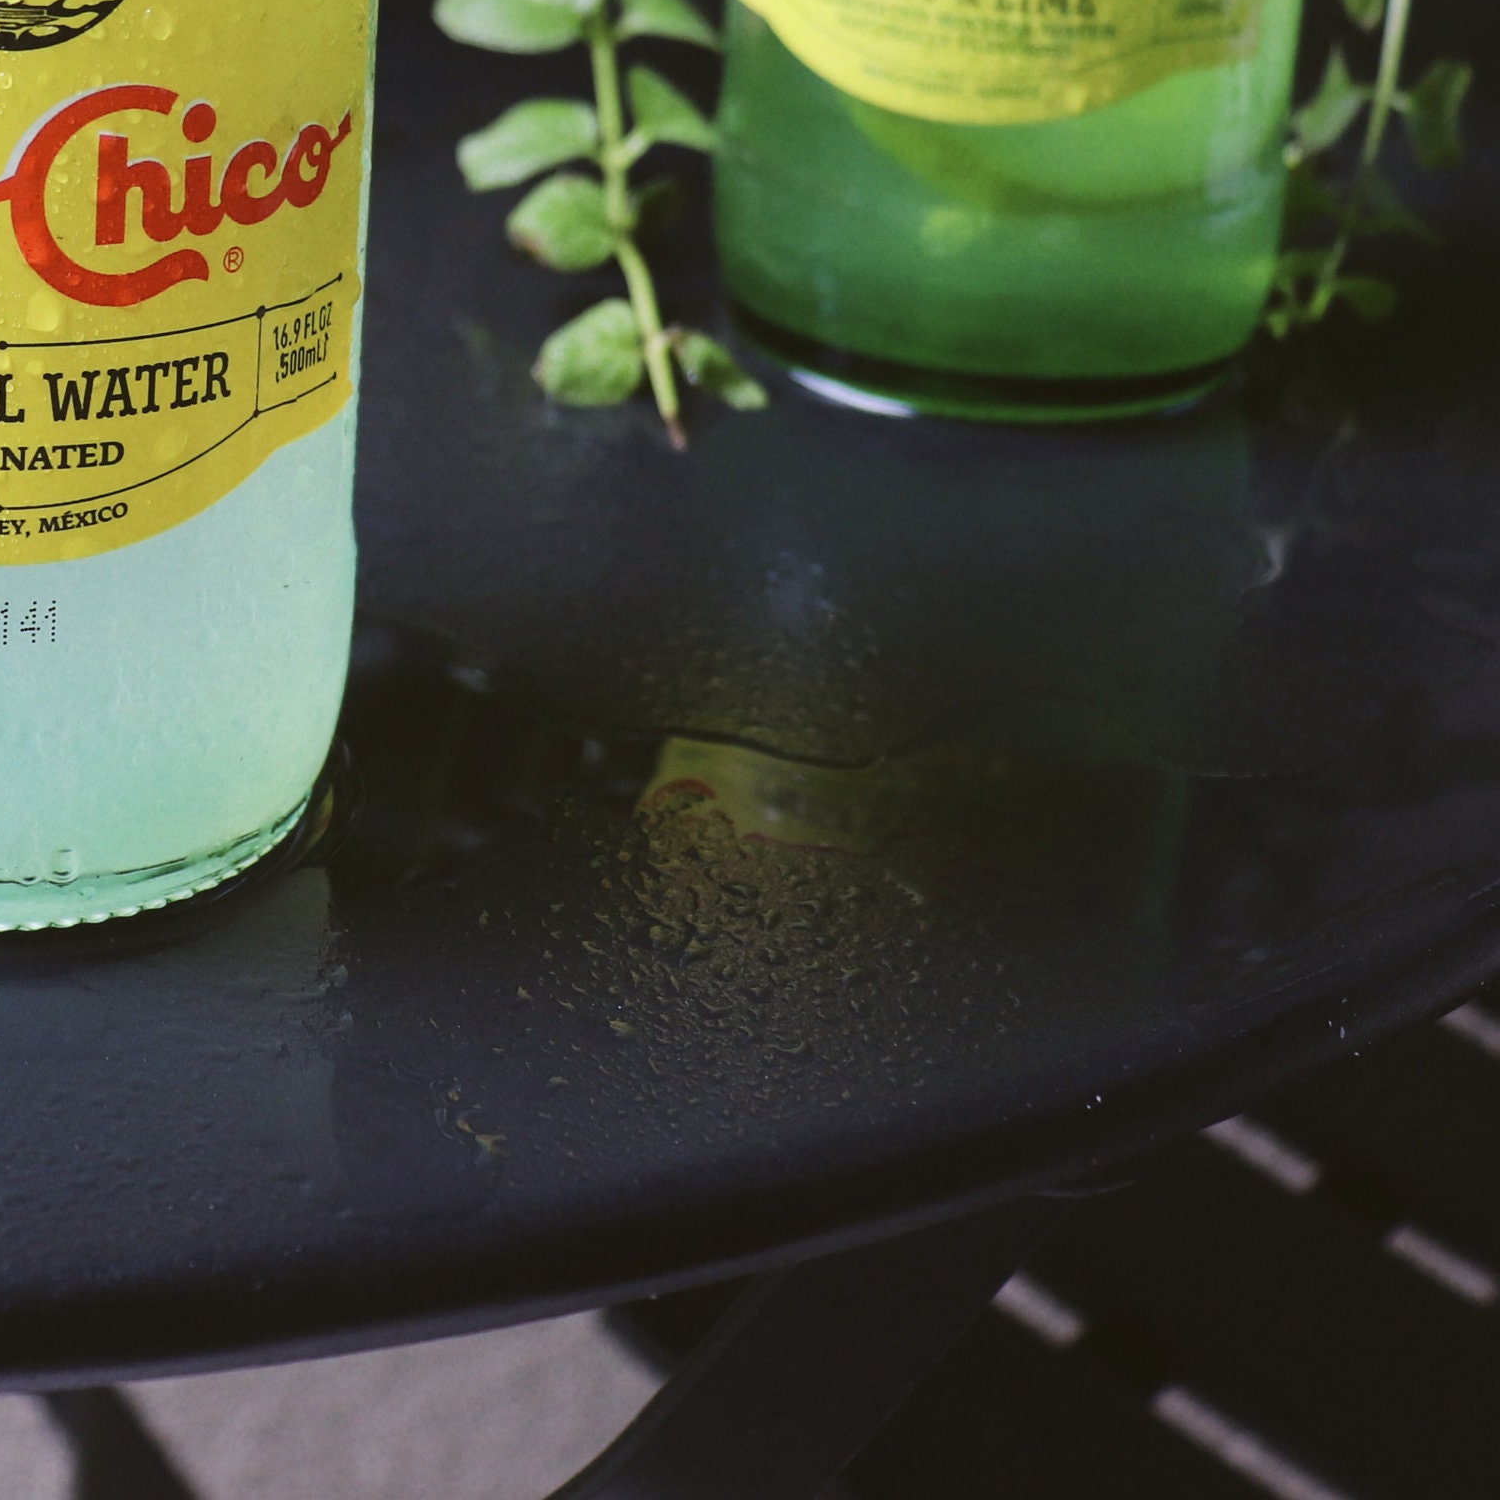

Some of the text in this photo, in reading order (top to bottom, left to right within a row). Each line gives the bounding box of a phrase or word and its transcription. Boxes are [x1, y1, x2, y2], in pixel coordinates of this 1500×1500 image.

[10, 84, 352, 308] Chico
[273, 317, 301, 350] 16.9
[304, 311, 317, 339] FL
[42, 352, 232, 422] WATER
[38, 501, 129, 534] MÉXICO
